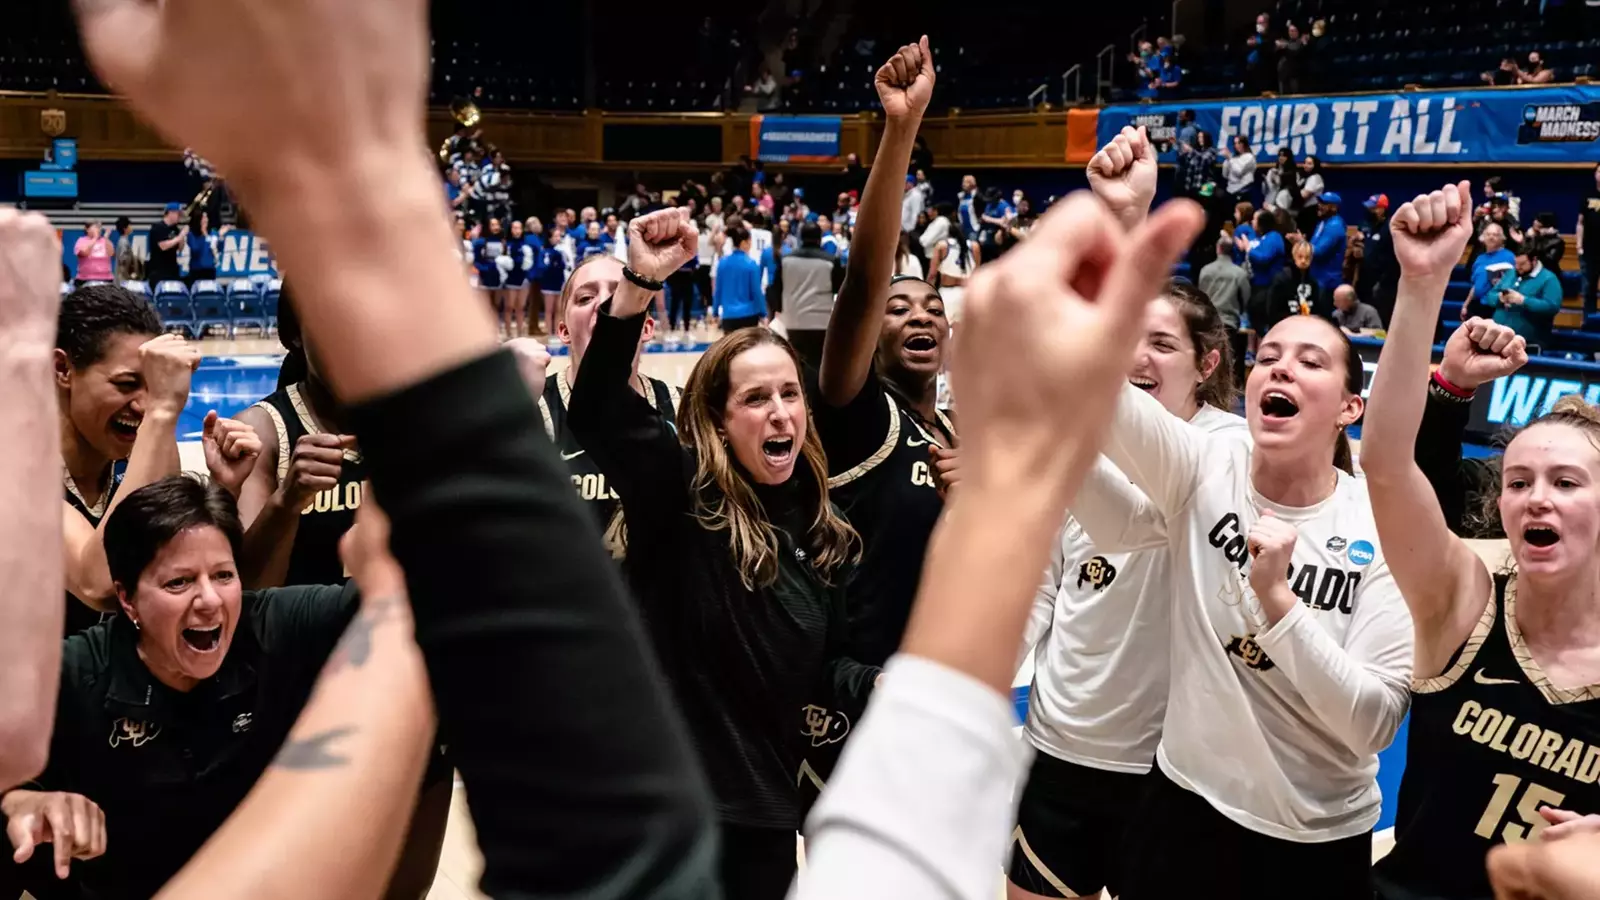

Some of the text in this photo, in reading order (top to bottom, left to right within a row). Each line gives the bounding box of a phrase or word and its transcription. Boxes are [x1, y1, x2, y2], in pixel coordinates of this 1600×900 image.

[1217, 97, 1462, 157] FOUR IT ALL
[1535, 106, 1581, 122] MARCH
[1540, 121, 1600, 137] MADNESS
[1350, 548, 1373, 561] NCAA
[1452, 700, 1600, 786] COLORAD
[1474, 773, 1566, 847] 15
